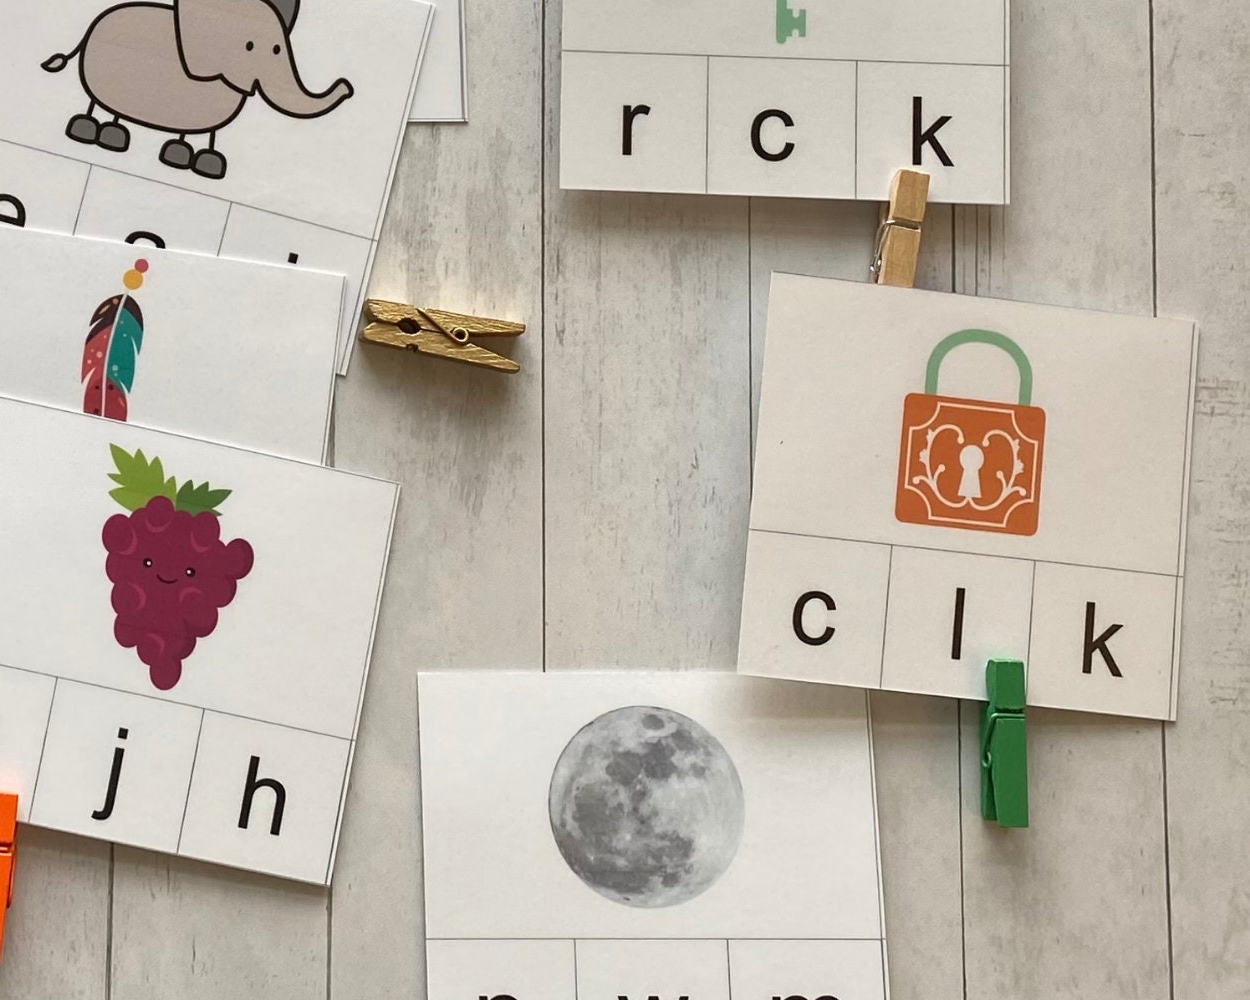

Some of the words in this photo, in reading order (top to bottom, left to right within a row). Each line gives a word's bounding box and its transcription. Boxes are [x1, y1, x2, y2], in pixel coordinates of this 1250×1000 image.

[623, 105, 650, 155] r
[751, 109, 794, 161] c
[913, 97, 954, 166] k
[793, 591, 836, 645] c
[952, 588, 965, 660] l
[1083, 602, 1123, 677] k
[92, 728, 128, 820] j
[238, 756, 285, 835] h
